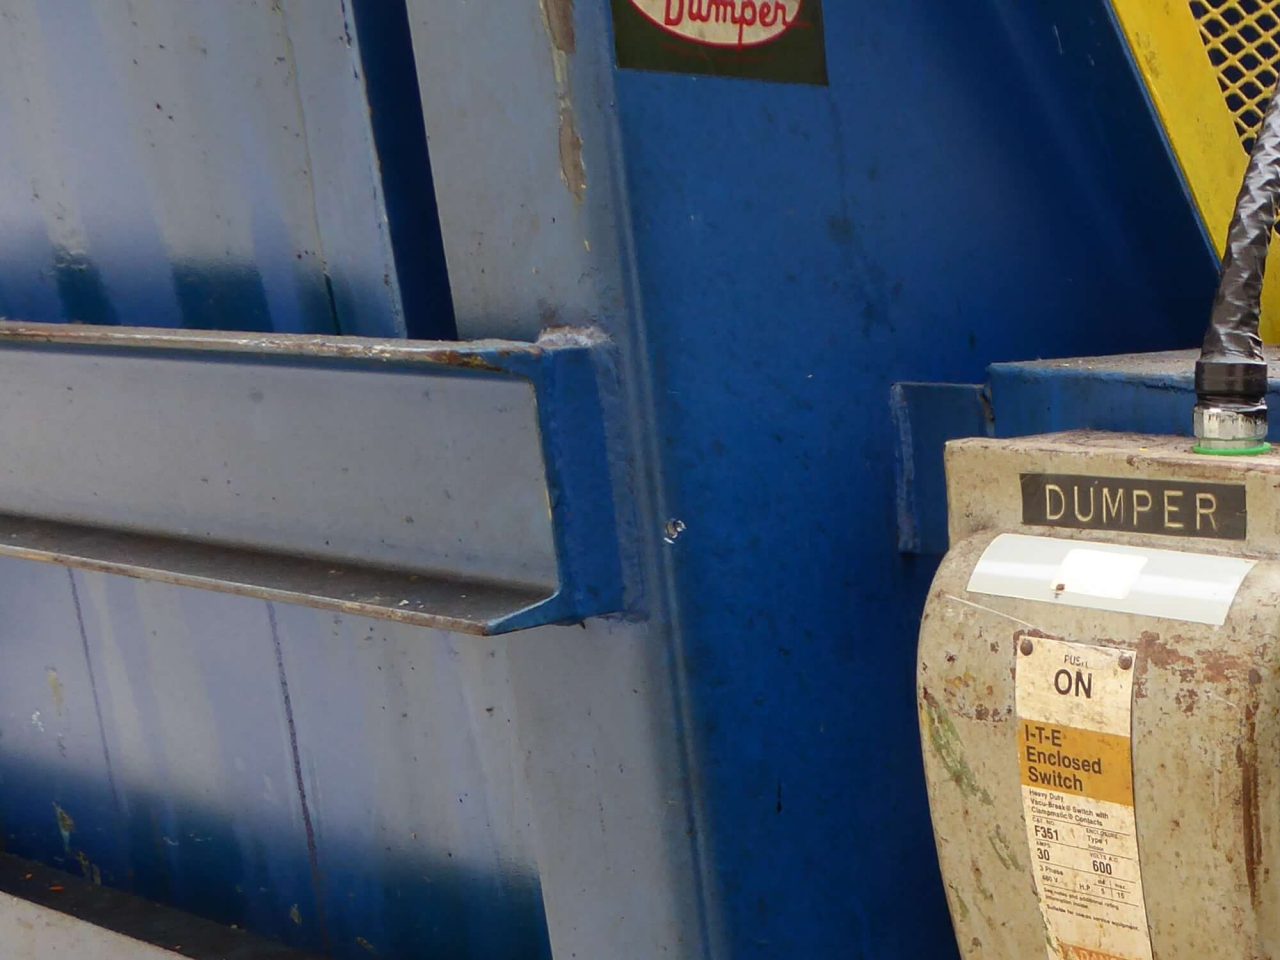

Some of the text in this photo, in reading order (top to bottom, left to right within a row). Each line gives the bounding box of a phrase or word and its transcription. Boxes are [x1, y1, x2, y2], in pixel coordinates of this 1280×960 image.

[664, 0, 796, 50] Dumper
[1045, 484, 1219, 531] DUMPER
[1054, 668, 1092, 699] ON
[1025, 724, 1062, 747] I-T-E
[1026, 745, 1102, 775] Enclosed
[1028, 766, 1083, 791] Switch
[1029, 788, 1064, 802] Heavy Duty
[1072, 805, 1094, 817] Switch
[1095, 811, 1109, 820] with
[1075, 814, 1103, 827] Contacts
[1034, 825, 1059, 841] F351
[1087, 835, 1103, 845] Type
[1036, 847, 1050, 861] 30
[1092, 859, 1113, 876] 600
